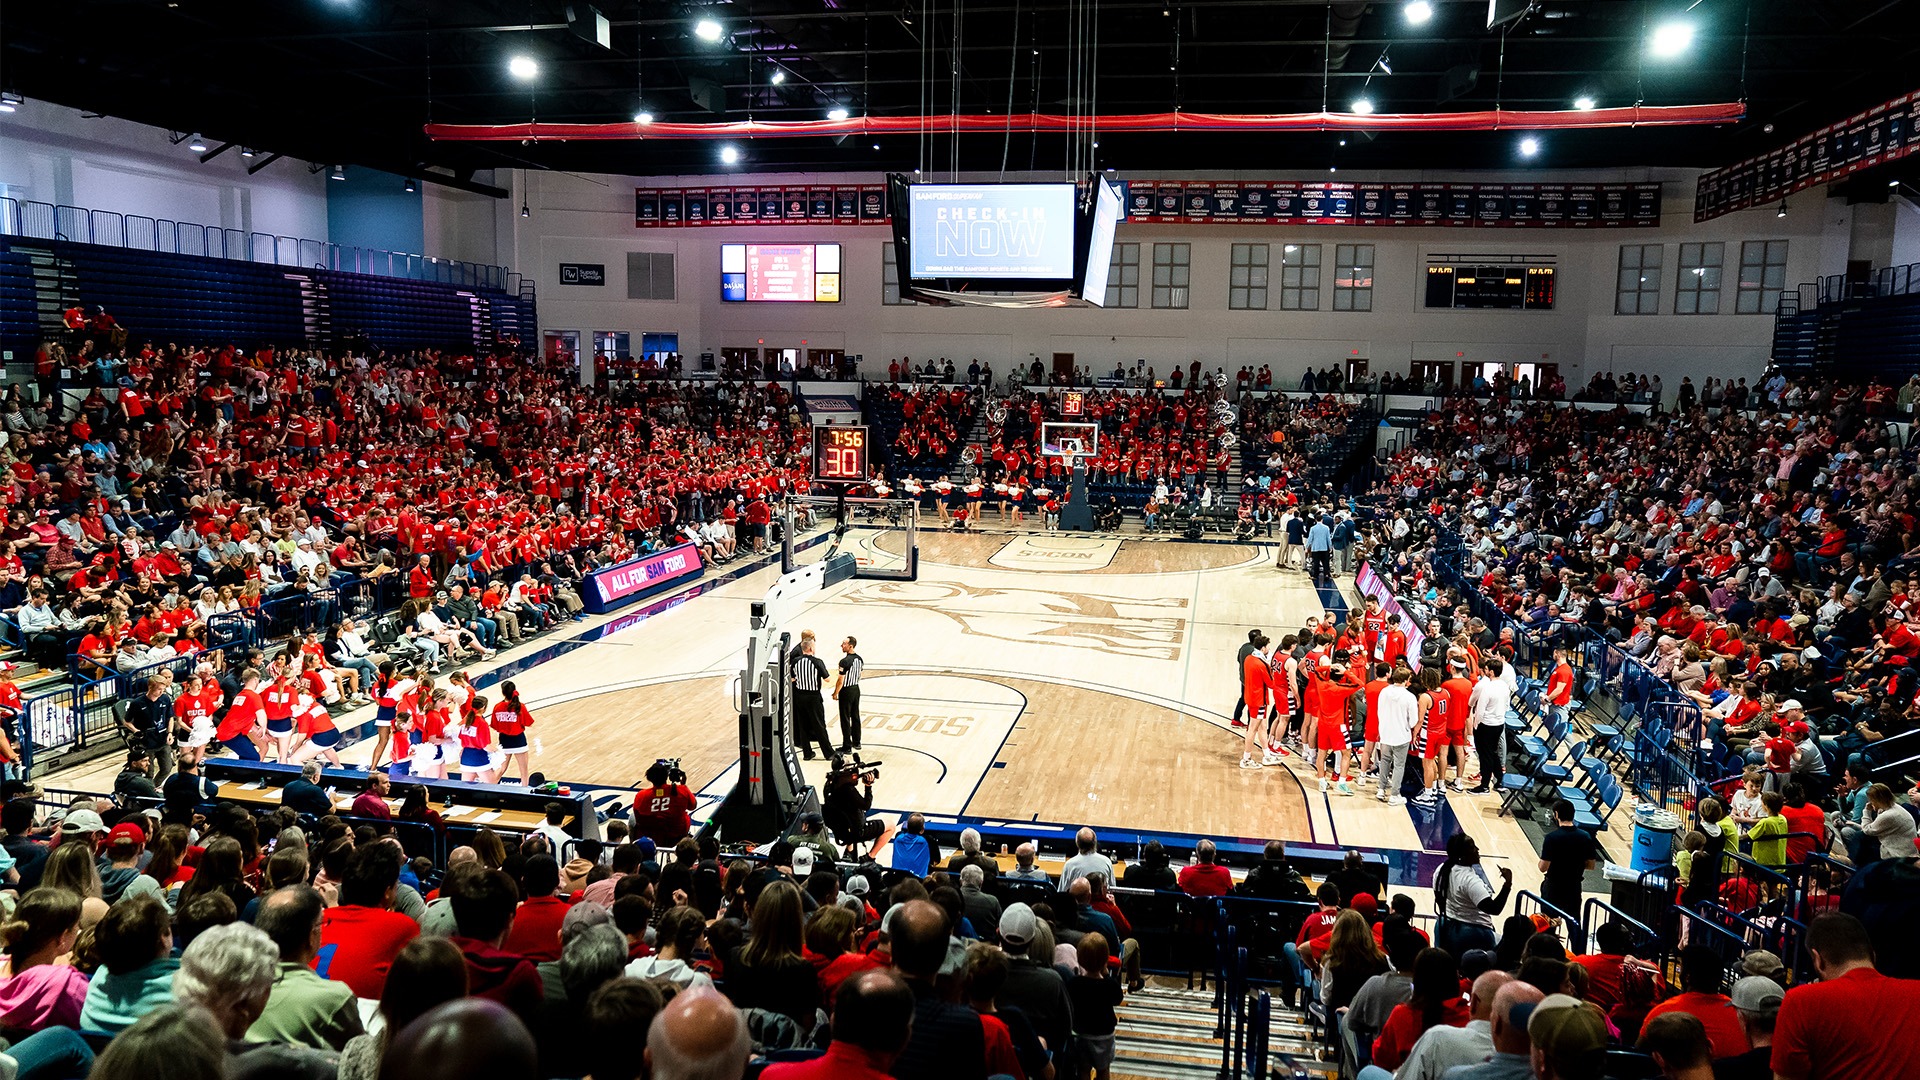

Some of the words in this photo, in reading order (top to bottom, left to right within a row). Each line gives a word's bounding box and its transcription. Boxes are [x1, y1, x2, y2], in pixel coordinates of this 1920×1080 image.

[937, 207, 1046, 220] CHECK-IN
[936, 219, 1047, 257] NOW
[1066, 401, 1079, 412] 30
[831, 431, 862, 447] 7:56
[827, 448, 857, 475] 30
[612, 571, 631, 593] ALL
[628, 566, 649, 586] FOR
[646, 554, 687, 580] SAMFORD
[1271, 659, 1282, 674] 24
[1305, 659, 1315, 673] 25
[1439, 699, 1447, 715] 11
[651, 797, 670, 812] 22
